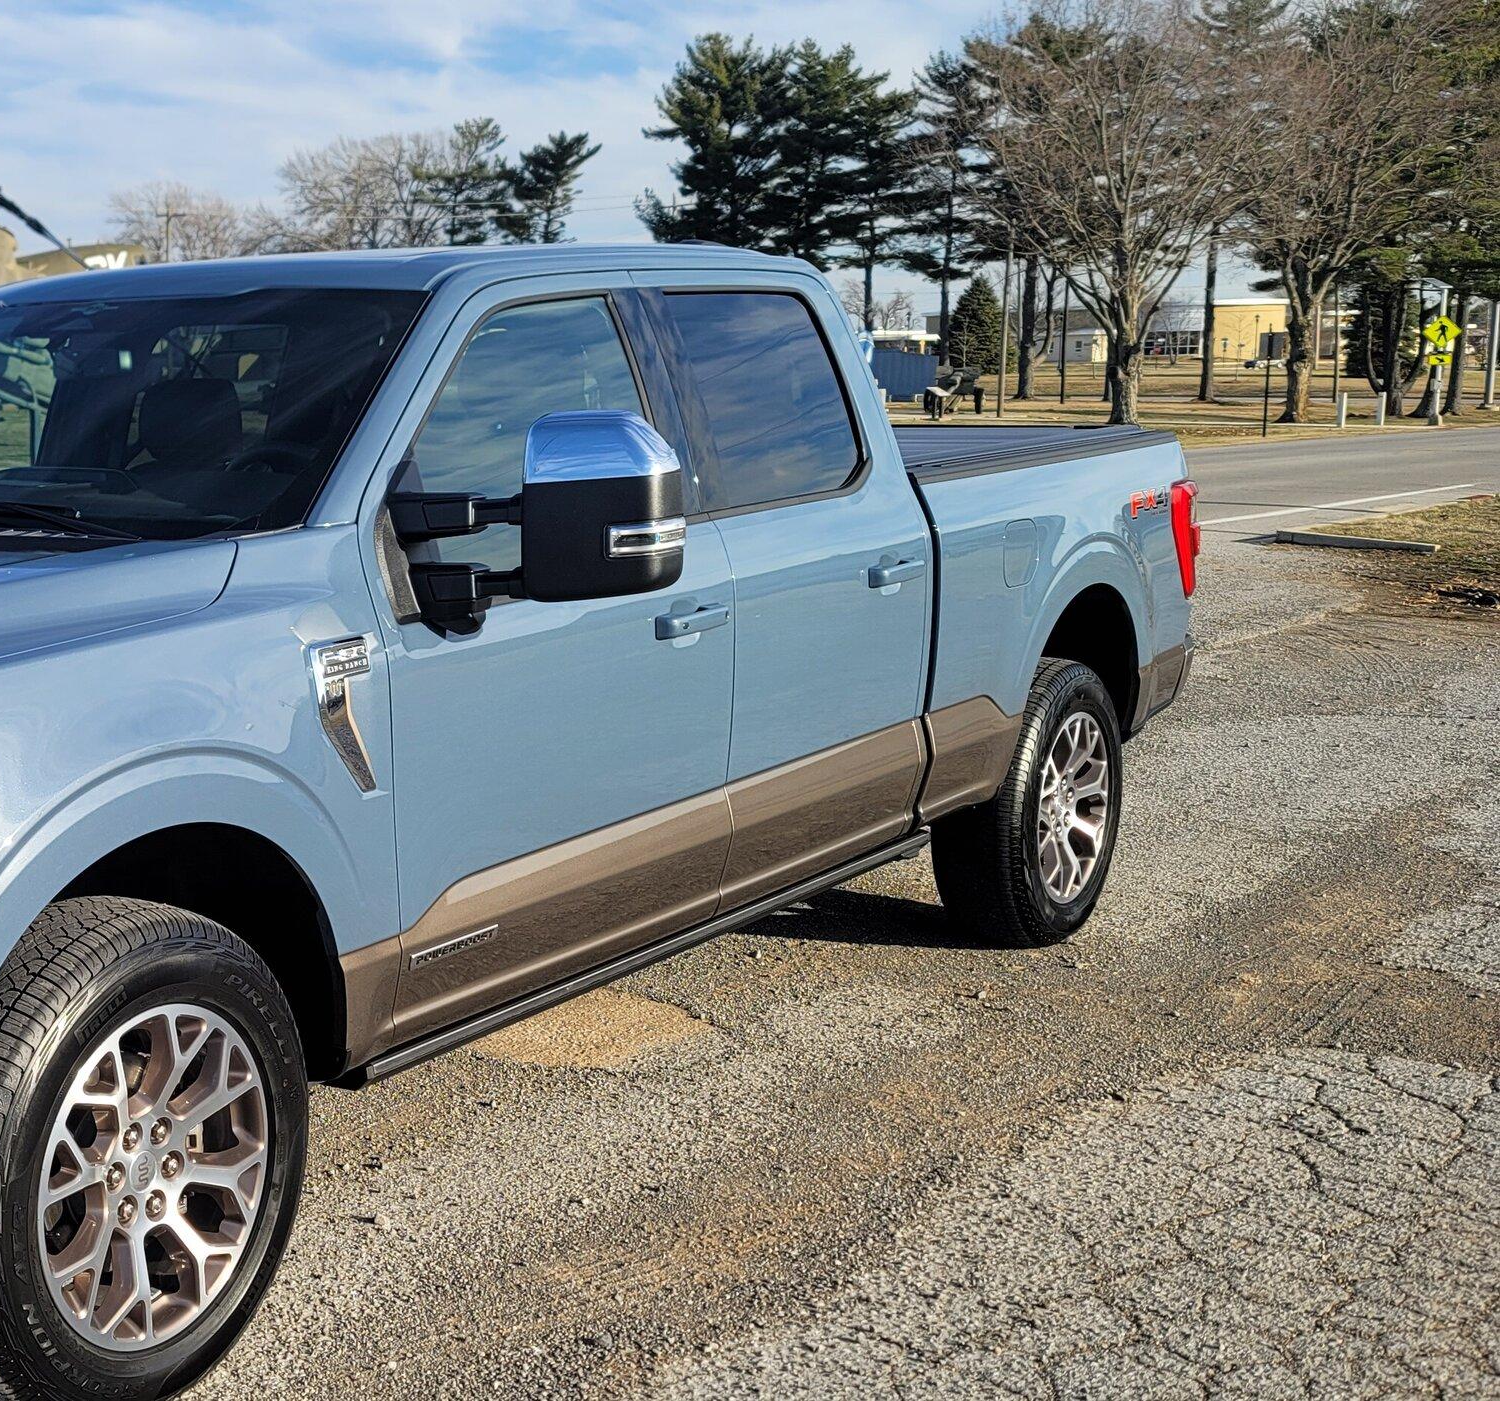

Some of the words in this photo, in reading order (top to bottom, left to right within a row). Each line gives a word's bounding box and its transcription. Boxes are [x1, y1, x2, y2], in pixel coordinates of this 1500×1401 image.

[1130, 486, 1168, 520] FX4
[326, 664, 344, 674] KING
[344, 657, 368, 670] RANCH
[415, 928, 496, 966] POWERBOOST
[222, 973, 290, 1065] PIRELLI
